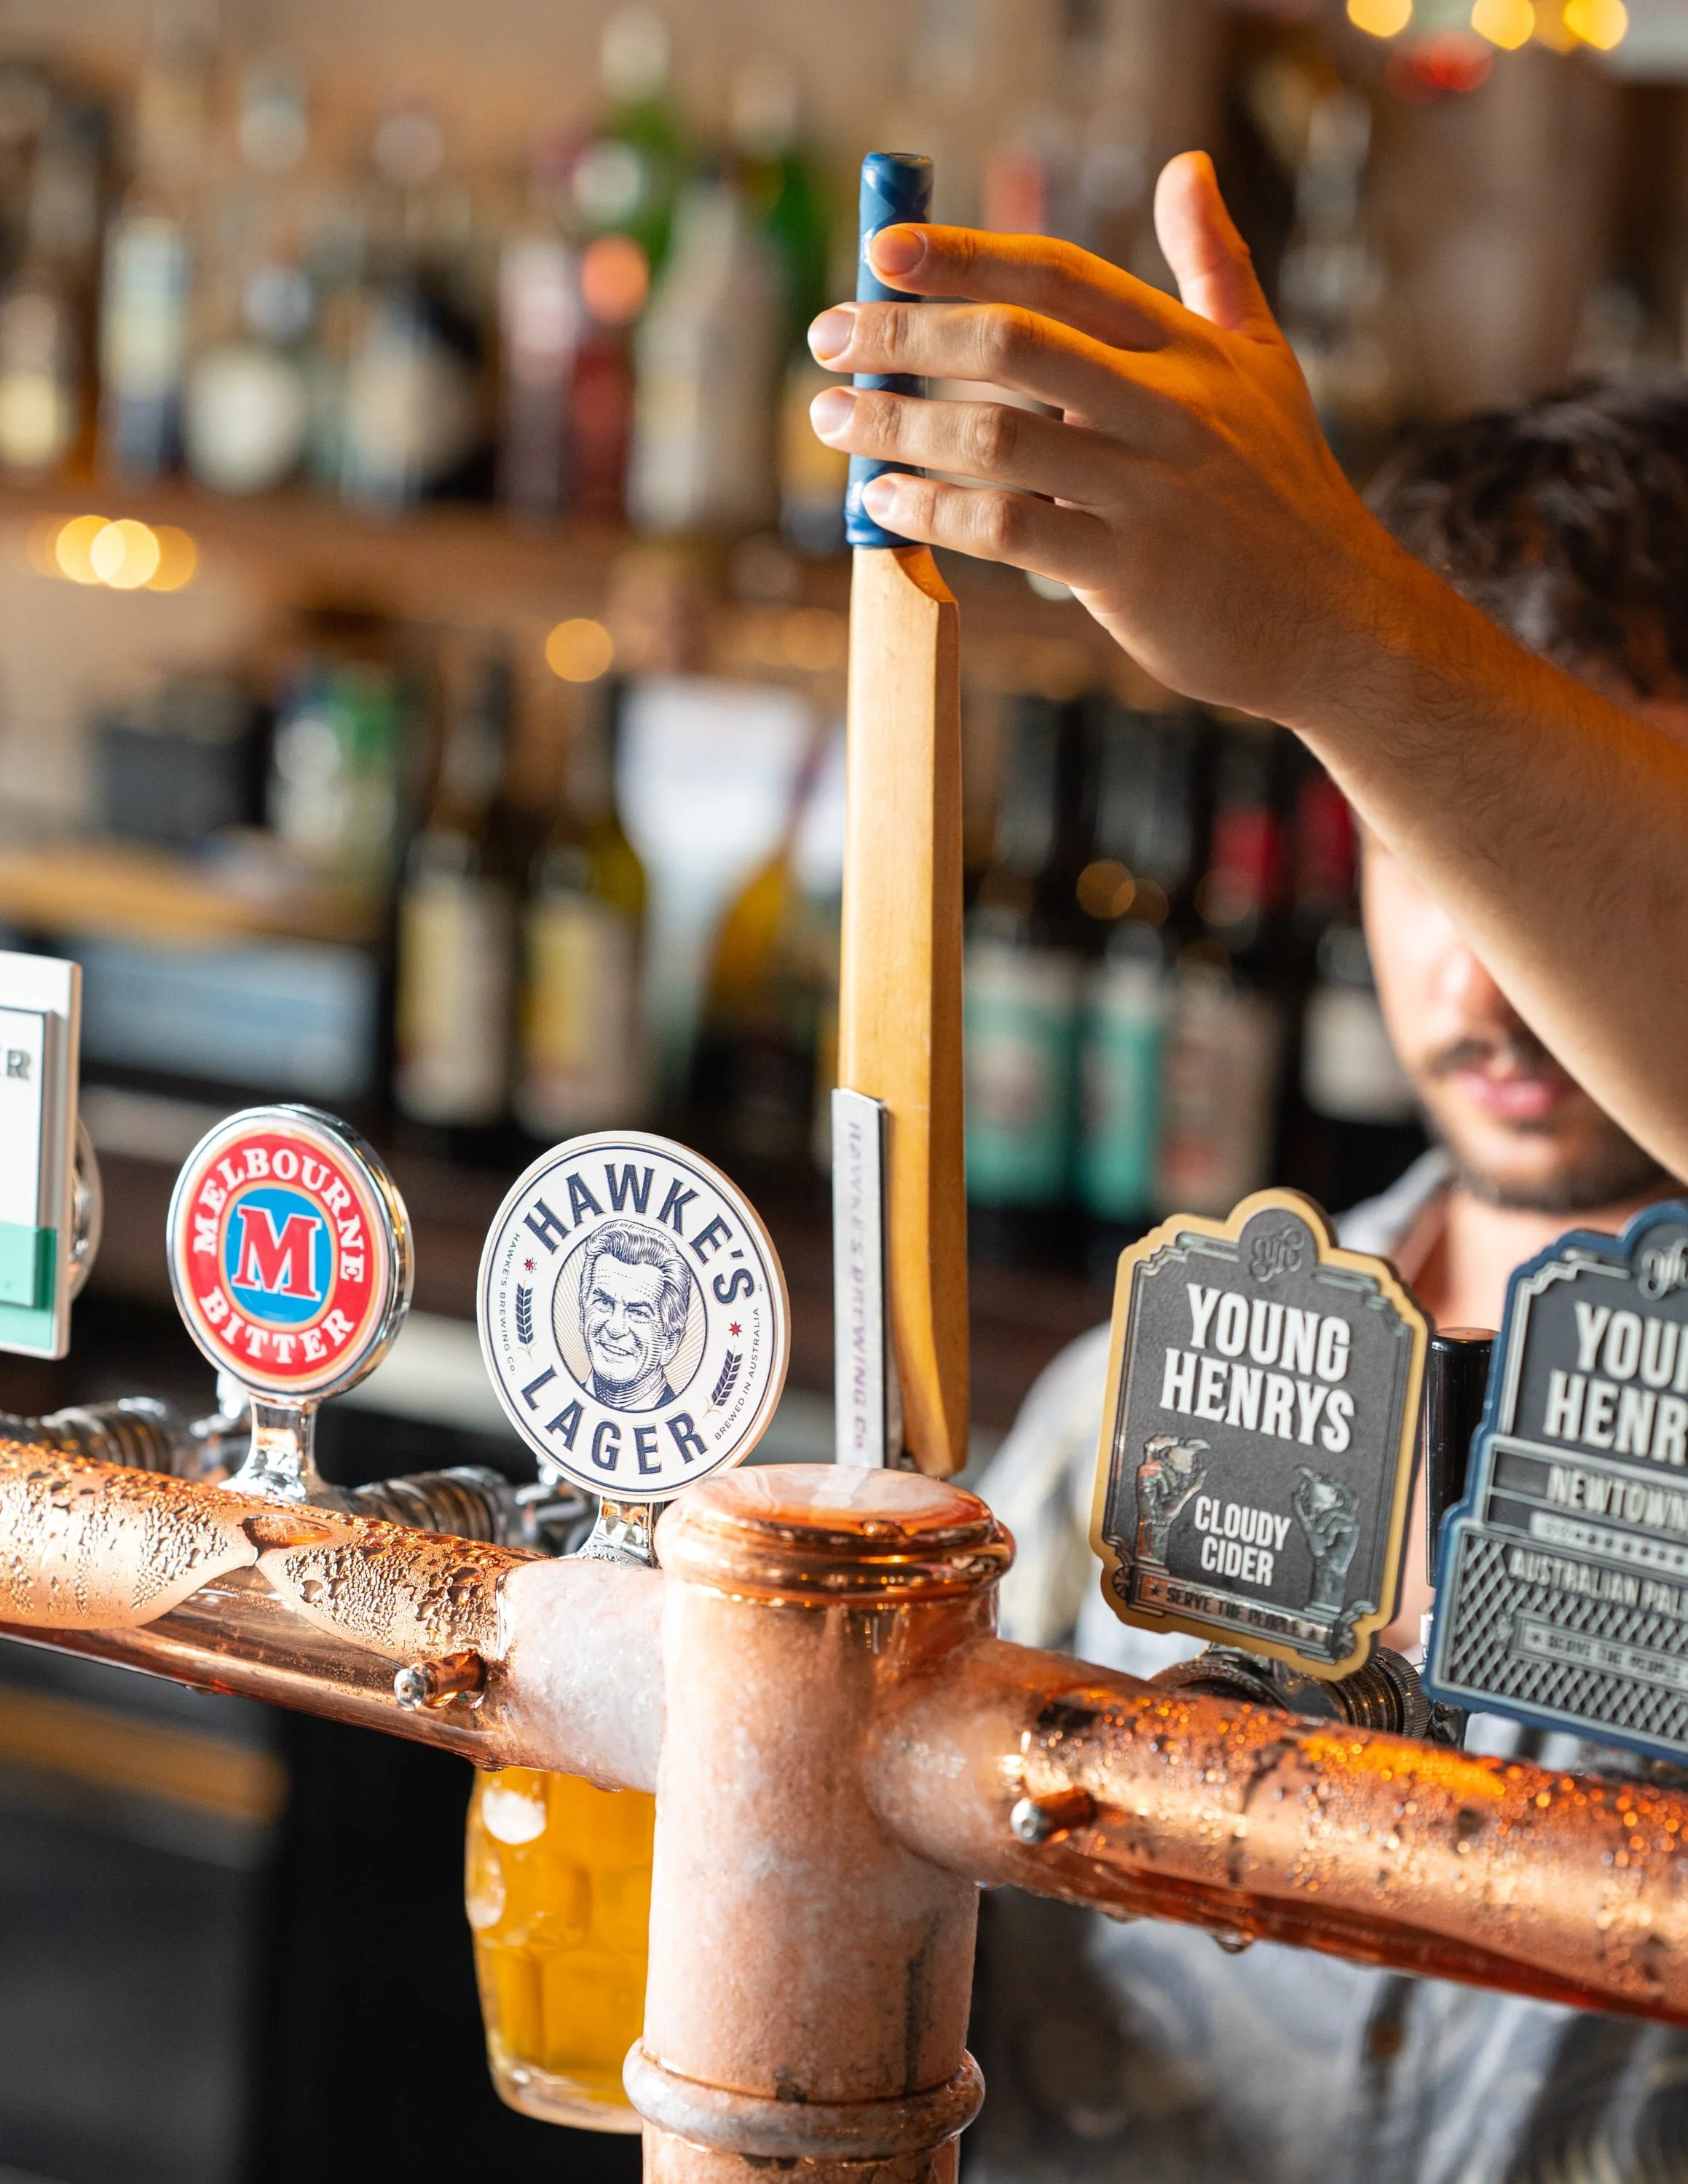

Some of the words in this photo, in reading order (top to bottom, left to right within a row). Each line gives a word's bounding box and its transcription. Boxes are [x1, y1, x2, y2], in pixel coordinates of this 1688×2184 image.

[0, 1045, 31, 1082] R
[193, 1147, 366, 1283] MELBOURNE
[522, 1163, 755, 1307] HAWKE'S
[232, 1205, 322, 1302] M
[501, 1233, 521, 1286] HAWKE'S
[198, 1286, 355, 1364] BITTER
[499, 1291, 510, 1352] BREWING
[1186, 1282, 1351, 1382] YOUNG
[714, 1397, 744, 1441] BREWED
[743, 1382, 752, 1395] IN
[749, 1307, 760, 1380] AUSTRALIA
[1159, 1347, 1356, 1454] HENRYS
[520, 1364, 709, 1476] LAGER
[1194, 1495, 1293, 1552] CLOUDY
[1546, 1464, 1688, 1532] NEWTOWN
[1200, 1535, 1274, 1587] CIDER
[1508, 1548, 1640, 1607] AUSTRALIAN
[1167, 1586, 1211, 1615] SERVE
[1217, 1600, 1242, 1620] THE
